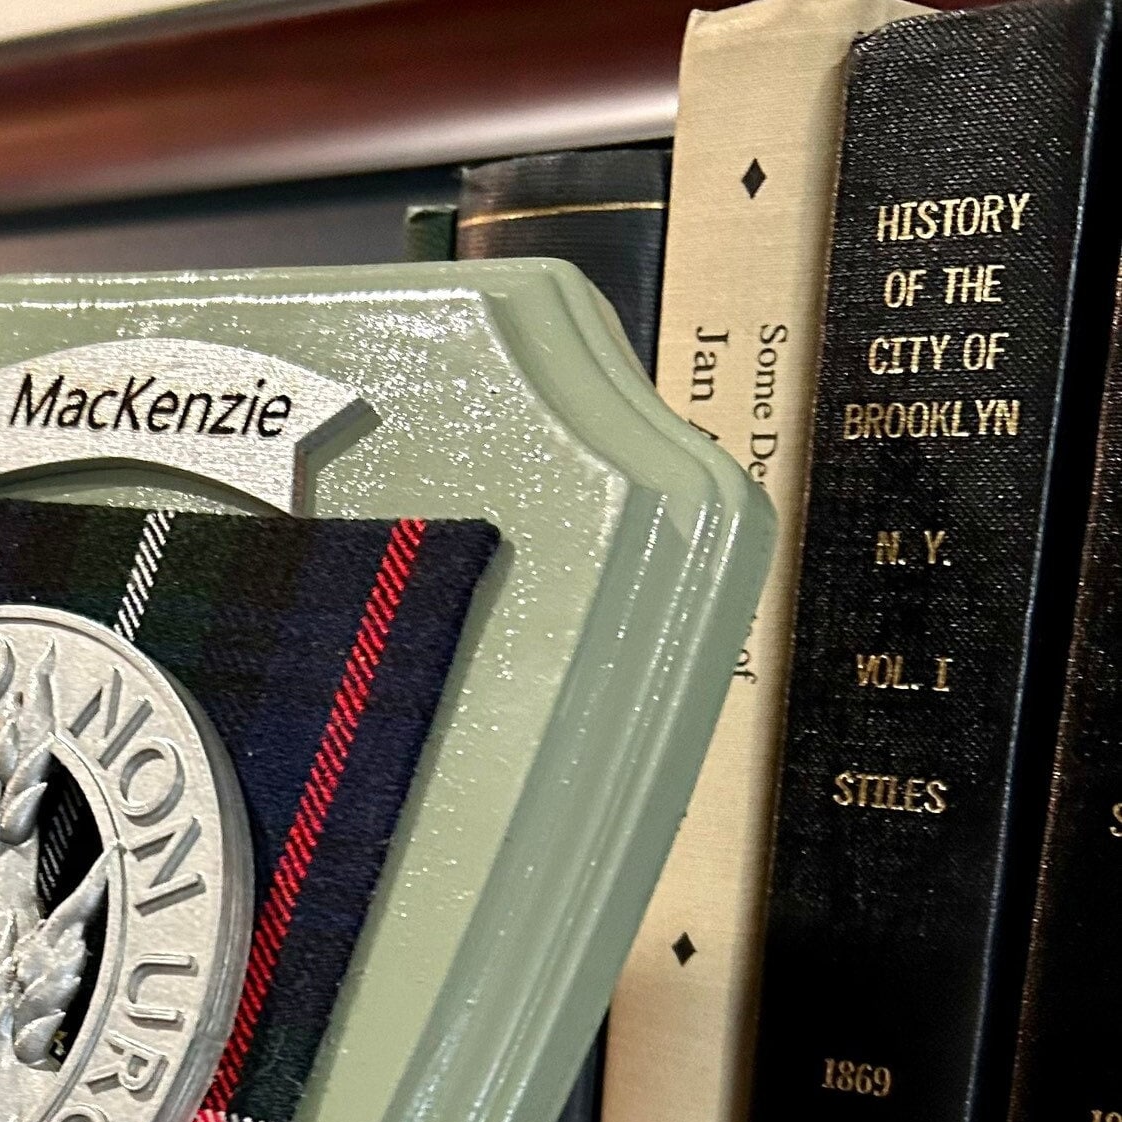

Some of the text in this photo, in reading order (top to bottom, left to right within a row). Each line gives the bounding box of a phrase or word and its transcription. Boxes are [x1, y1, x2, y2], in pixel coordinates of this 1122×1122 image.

[878, 192, 1031, 242] HISTORY
[884, 264, 1007, 308] OF THE
[689, 325, 730, 403] Jan
[868, 332, 1010, 375] CITY OF
[9, 373, 293, 438] MacKenzie
[747, 323, 789, 488] Some De
[843, 400, 1020, 440] BROOKLYN
[876, 530, 952, 567] N. Y.
[856, 653, 955, 692] VOL. I
[68, 667, 206, 916] NON
[832, 771, 947, 814] STILES
[821, 1057, 892, 1098] 1869
